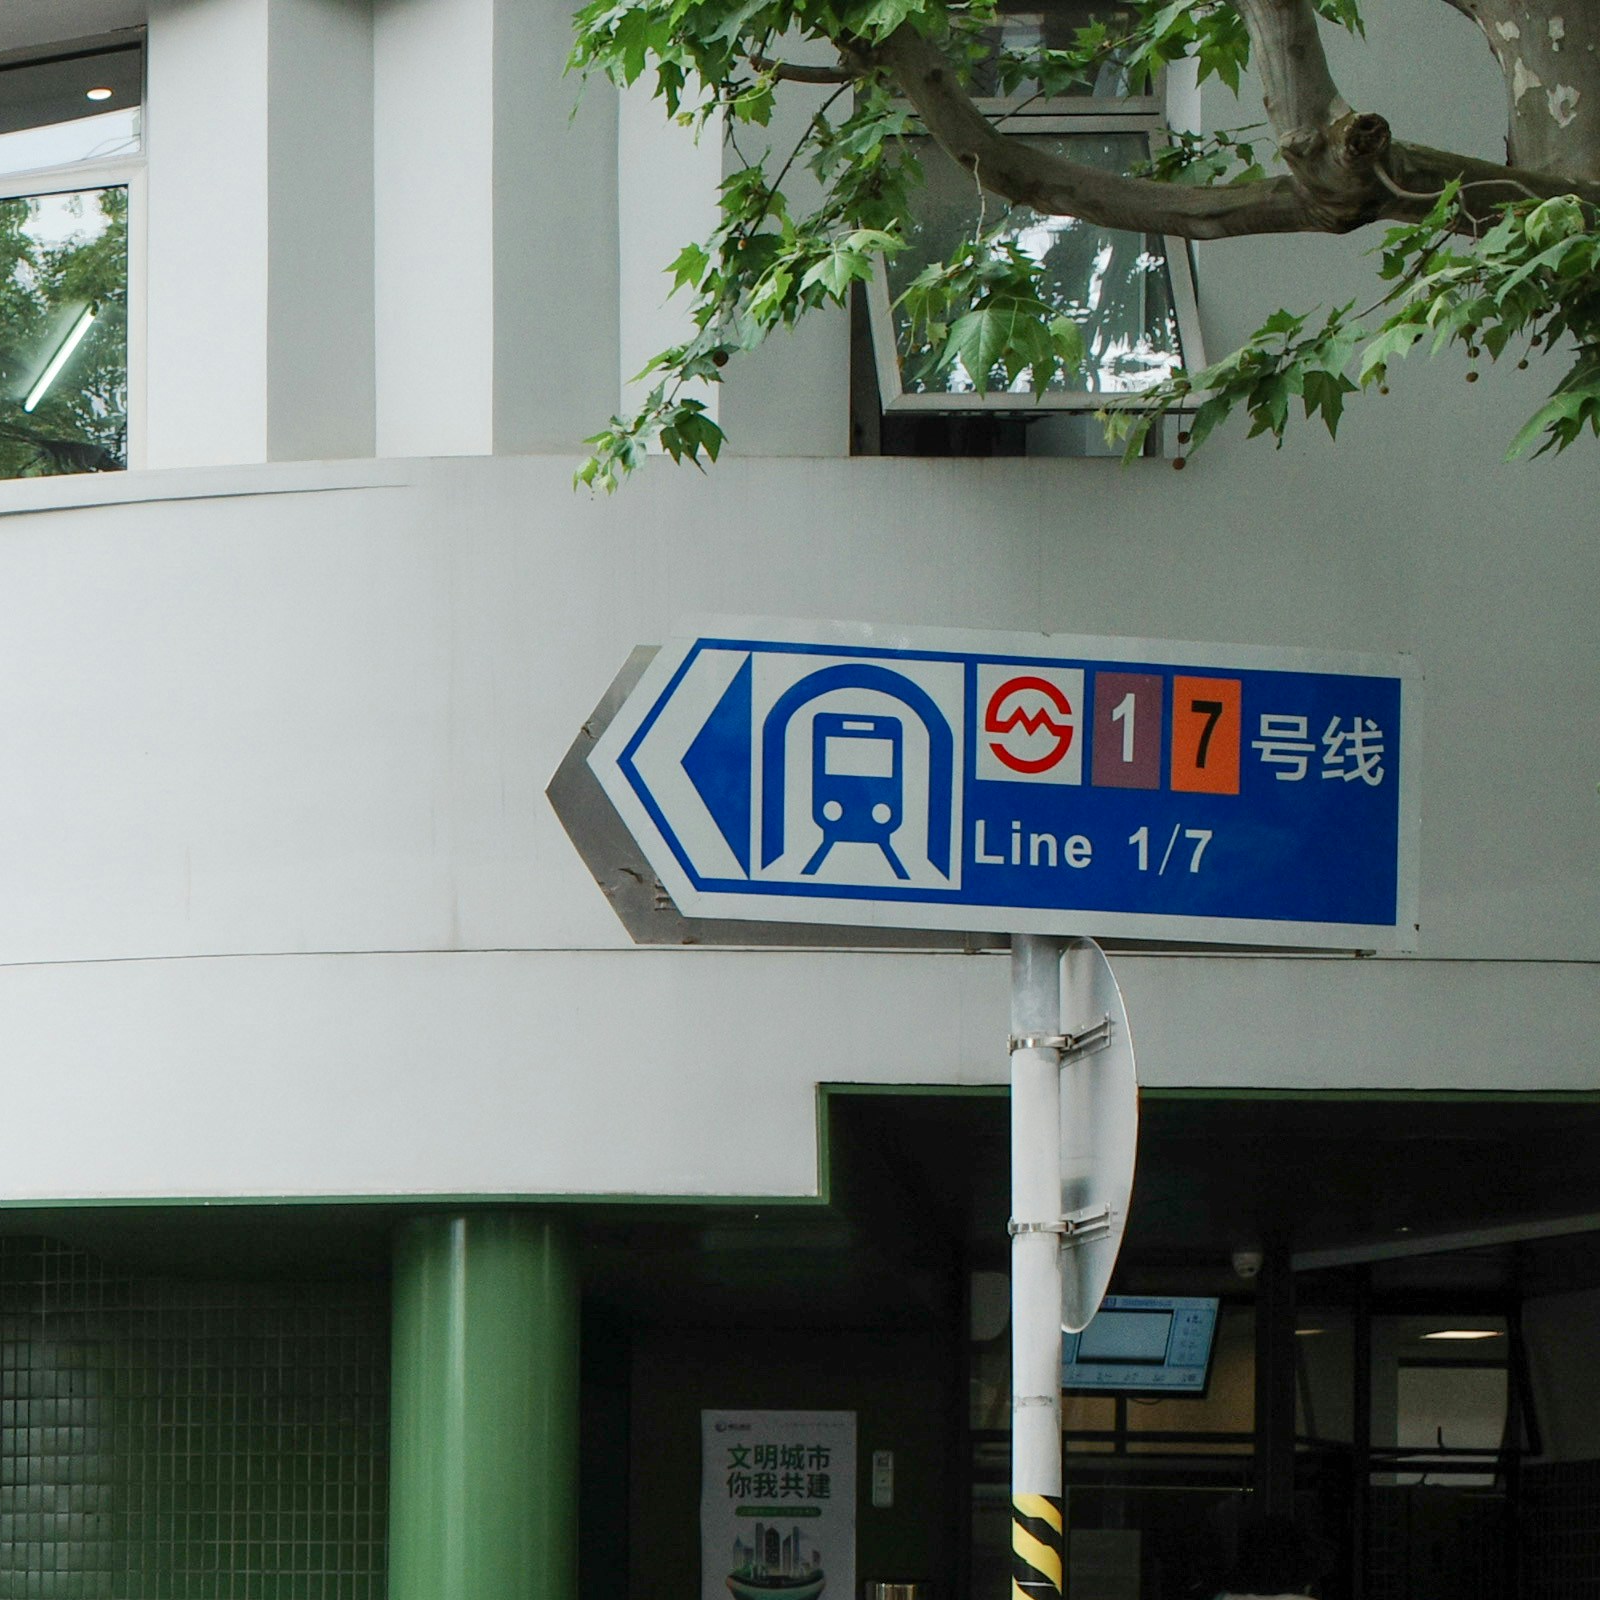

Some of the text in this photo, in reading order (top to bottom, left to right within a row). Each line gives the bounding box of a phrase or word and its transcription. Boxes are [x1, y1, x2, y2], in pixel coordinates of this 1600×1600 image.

[1111, 691, 1385, 787] 1 7 号线
[974, 820, 1214, 876] Line 1/7
[727, 1442, 831, 1472] 文明城市
[726, 1472, 831, 1500] 你我共建
